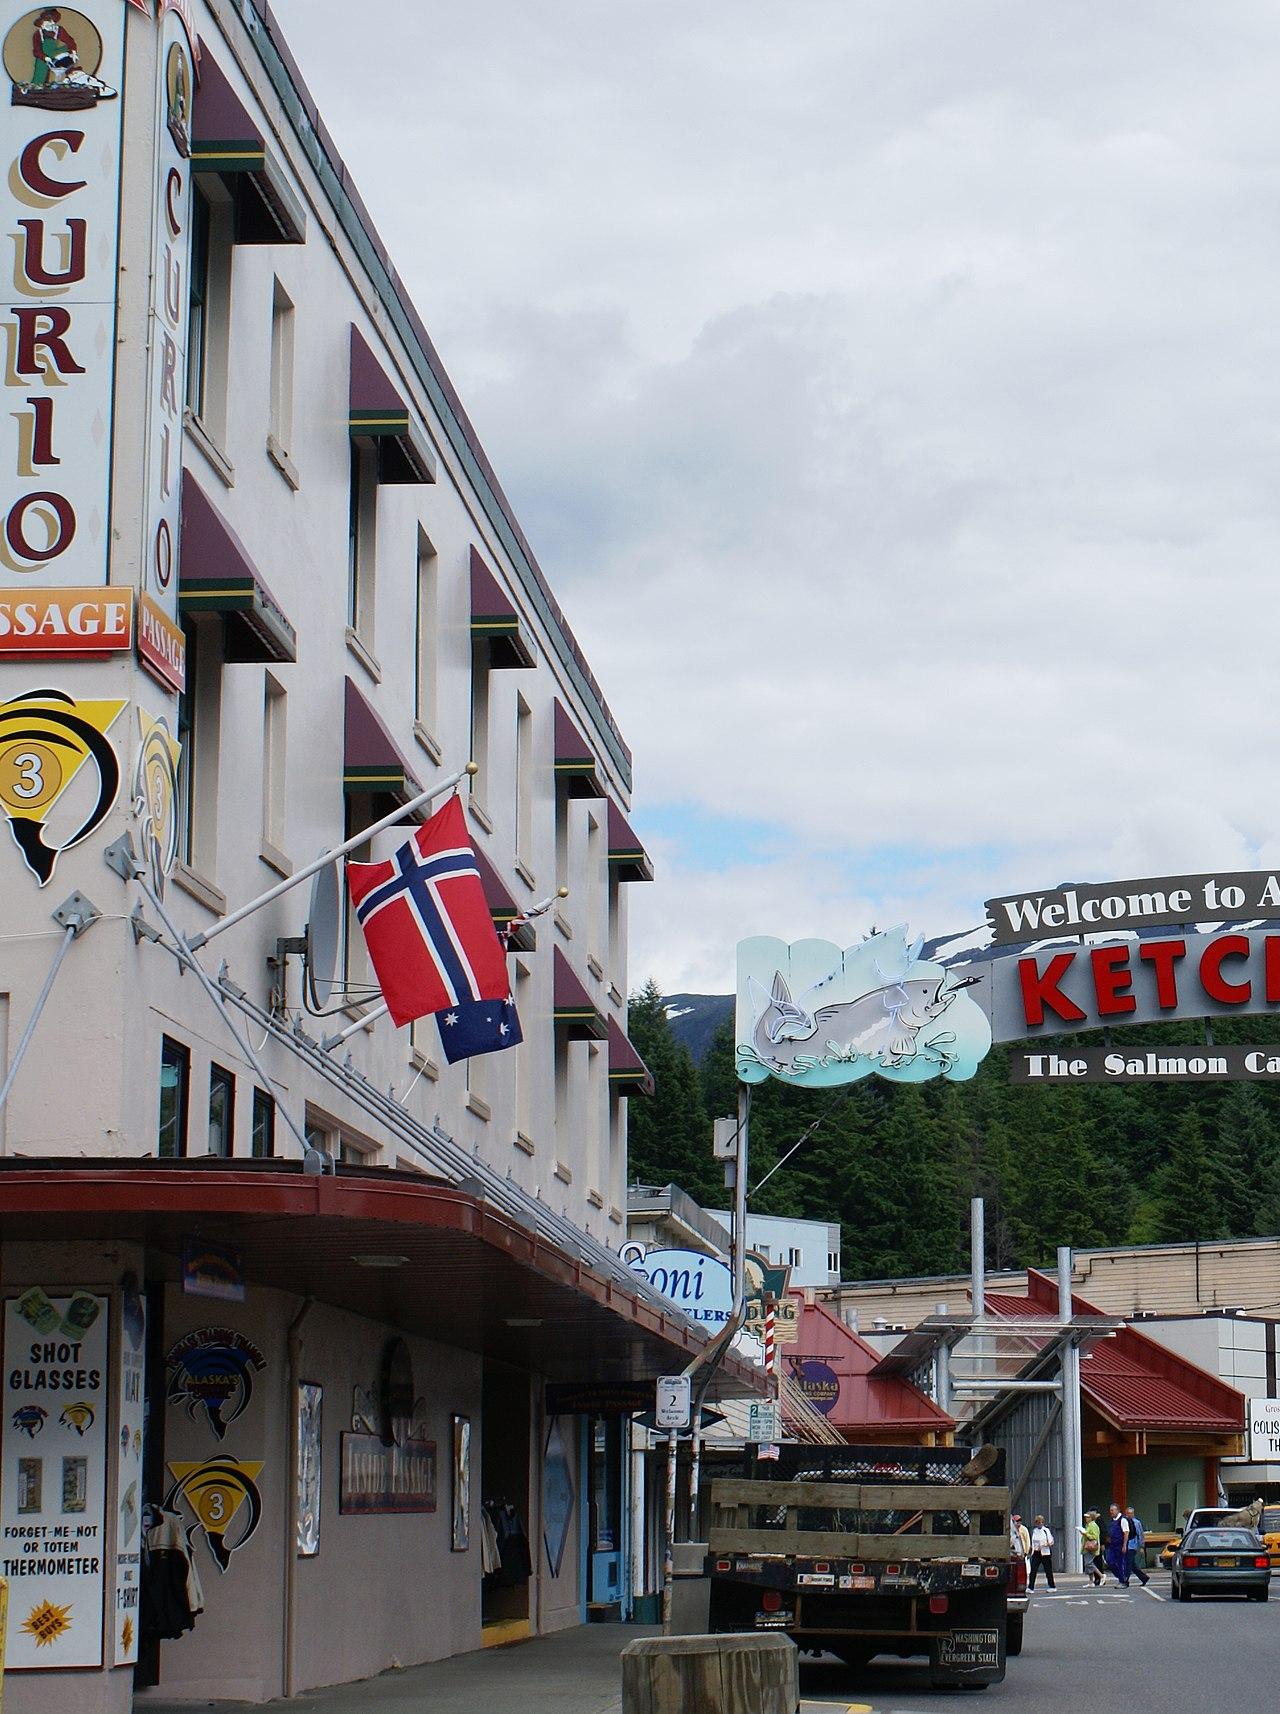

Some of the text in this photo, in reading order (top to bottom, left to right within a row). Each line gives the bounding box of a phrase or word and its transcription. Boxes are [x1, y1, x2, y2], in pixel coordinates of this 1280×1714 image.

[4, 130, 87, 563] CURIO
[153, 166, 182, 590] CURIO
[12, 752, 45, 798] 3
[1002, 896, 1191, 933] Welcome
[1203, 879, 1246, 910] to
[1023, 1054, 1088, 1077] The
[1105, 1052, 1228, 1076] Salmon
[30, 1342, 82, 1363] SHOT
[10, 1369, 100, 1391] GLASSES
[186, 1374, 240, 1385] ALASKA'S
[669, 1394, 677, 1407] 2
[752, 1405, 758, 1416] 2
[209, 1492, 225, 1520] 3
[4, 1526, 98, 1538] FORGET-ME-NOT
[23, 1541, 79, 1553] OR TOTEM
[3, 1558, 99, 1576] THERMOMETER
[31, 1609, 55, 1631] BEST
[38, 1618, 63, 1640] BUYS
[955, 1633, 996, 1644] WASHINGTON
[941, 1653, 996, 1663] EVERGREEN STATE
